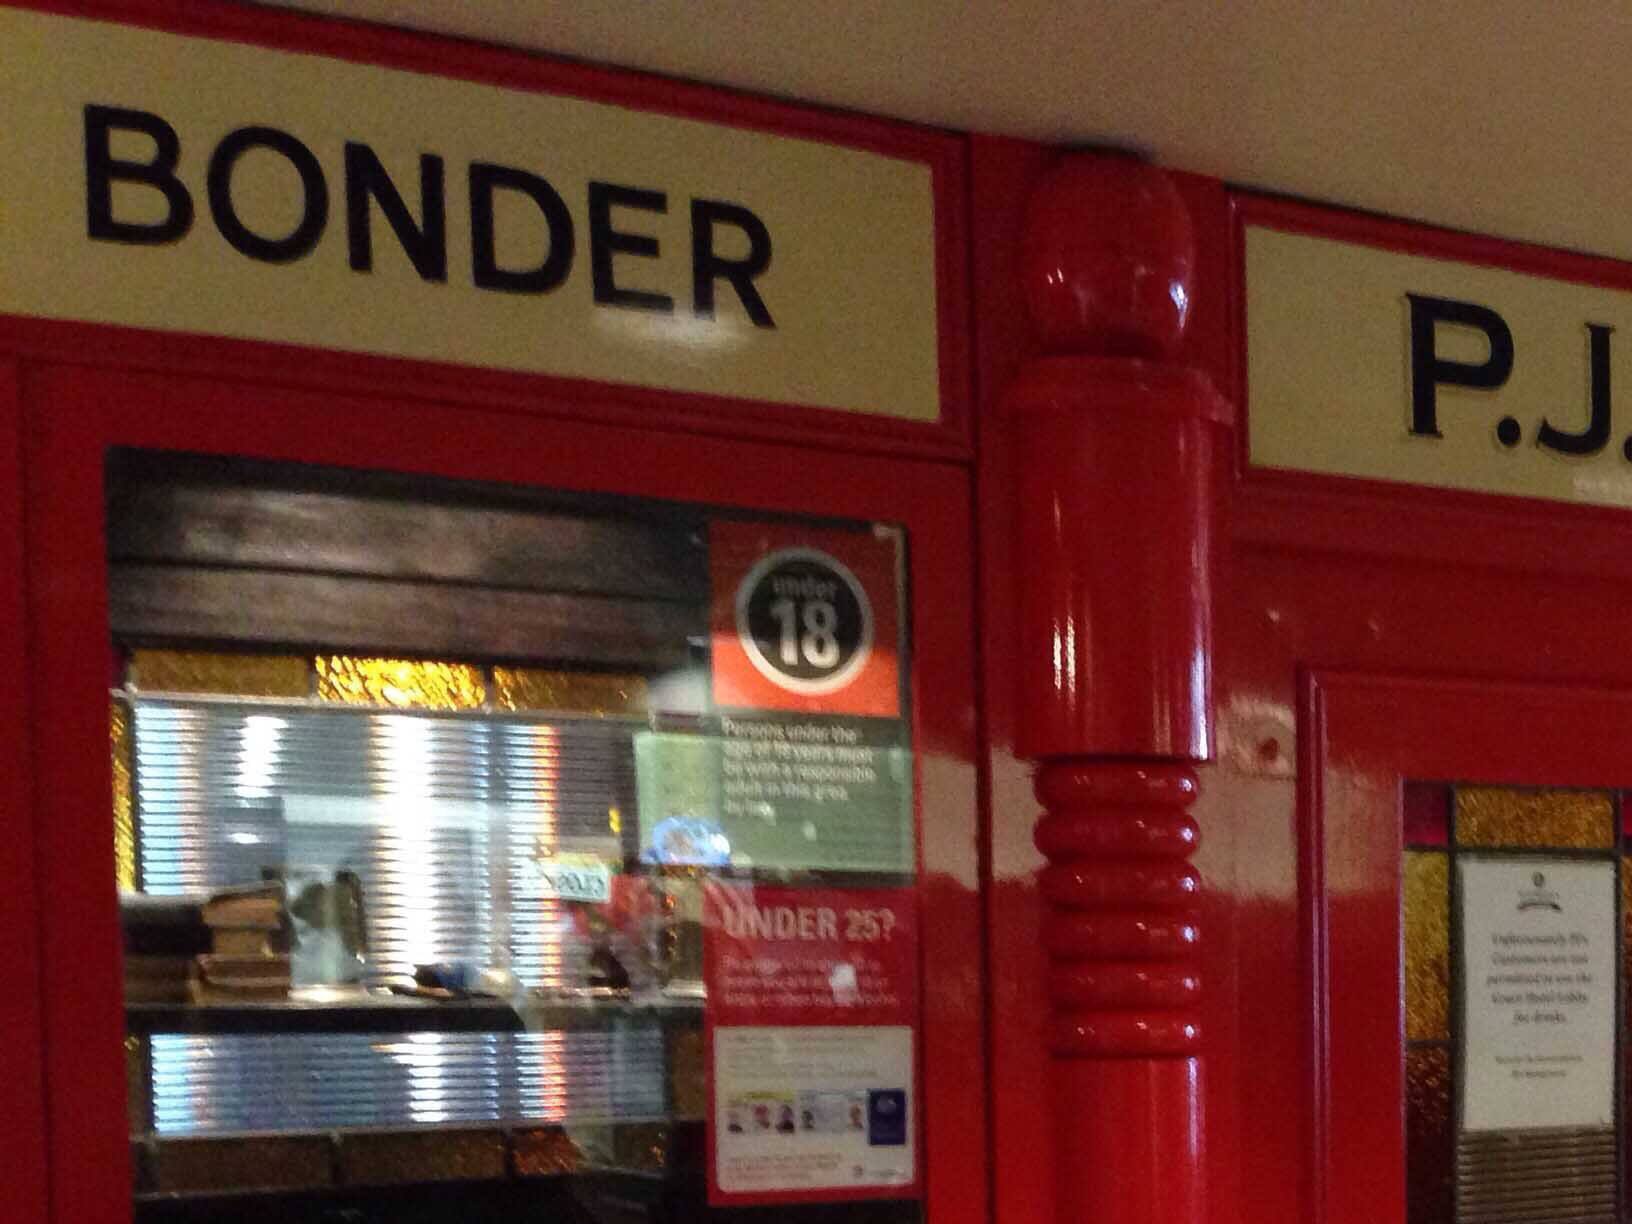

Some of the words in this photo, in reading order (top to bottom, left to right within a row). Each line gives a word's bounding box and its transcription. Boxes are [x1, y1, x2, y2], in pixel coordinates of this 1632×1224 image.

[83, 103, 777, 331] BONDER
[769, 599, 841, 669] 18
[722, 905, 839, 942] UNDER
